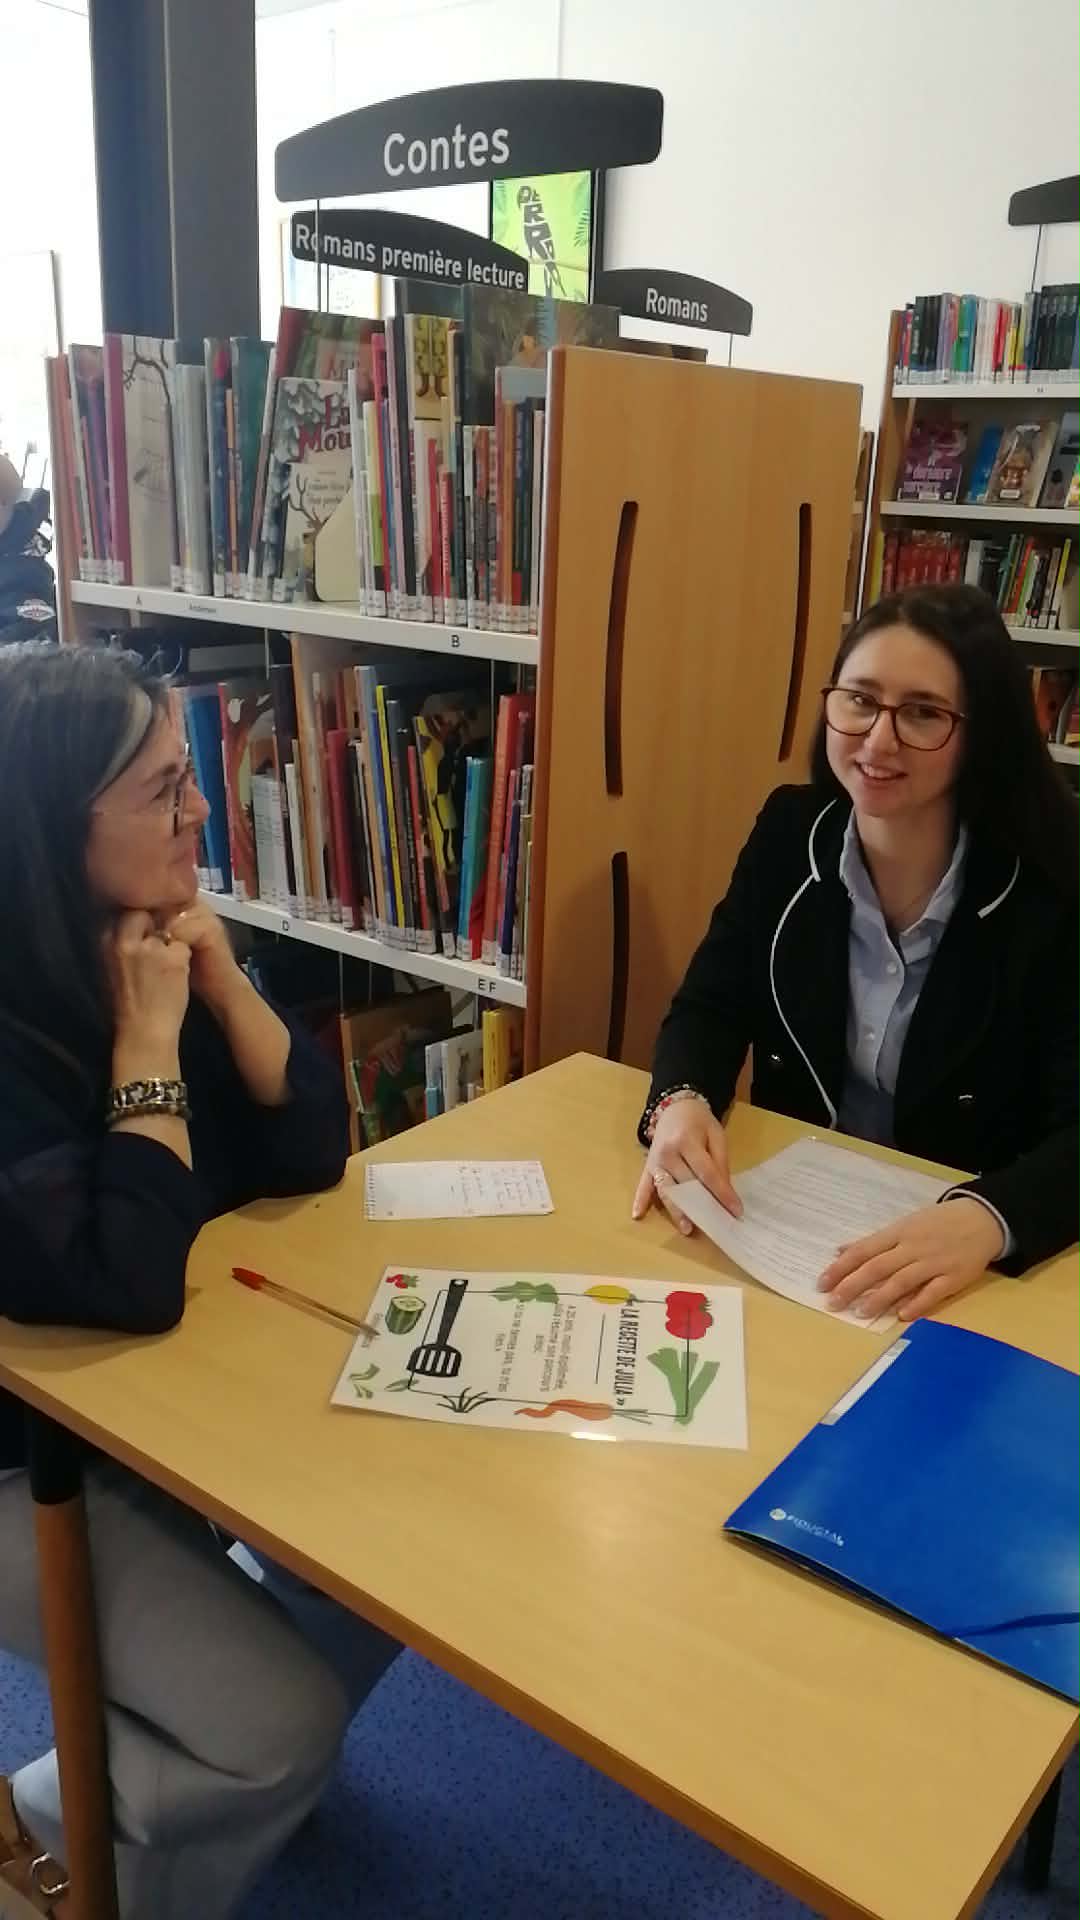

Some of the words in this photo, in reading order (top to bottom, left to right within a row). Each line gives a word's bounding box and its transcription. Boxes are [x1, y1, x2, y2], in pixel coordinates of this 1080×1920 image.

[383, 123, 510, 177] Contes
[382, 246, 462, 279] première
[467, 258, 525, 289] lecture
[645, 287, 709, 323] Romans
[294, 421, 352, 463] Mou
[451, 634, 461, 648] B
[620, 1307, 640, 1319] LA
[616, 1320, 639, 1354] RECETTE
[615, 1355, 636, 1368] DE
[612, 1368, 635, 1395] JULIA
